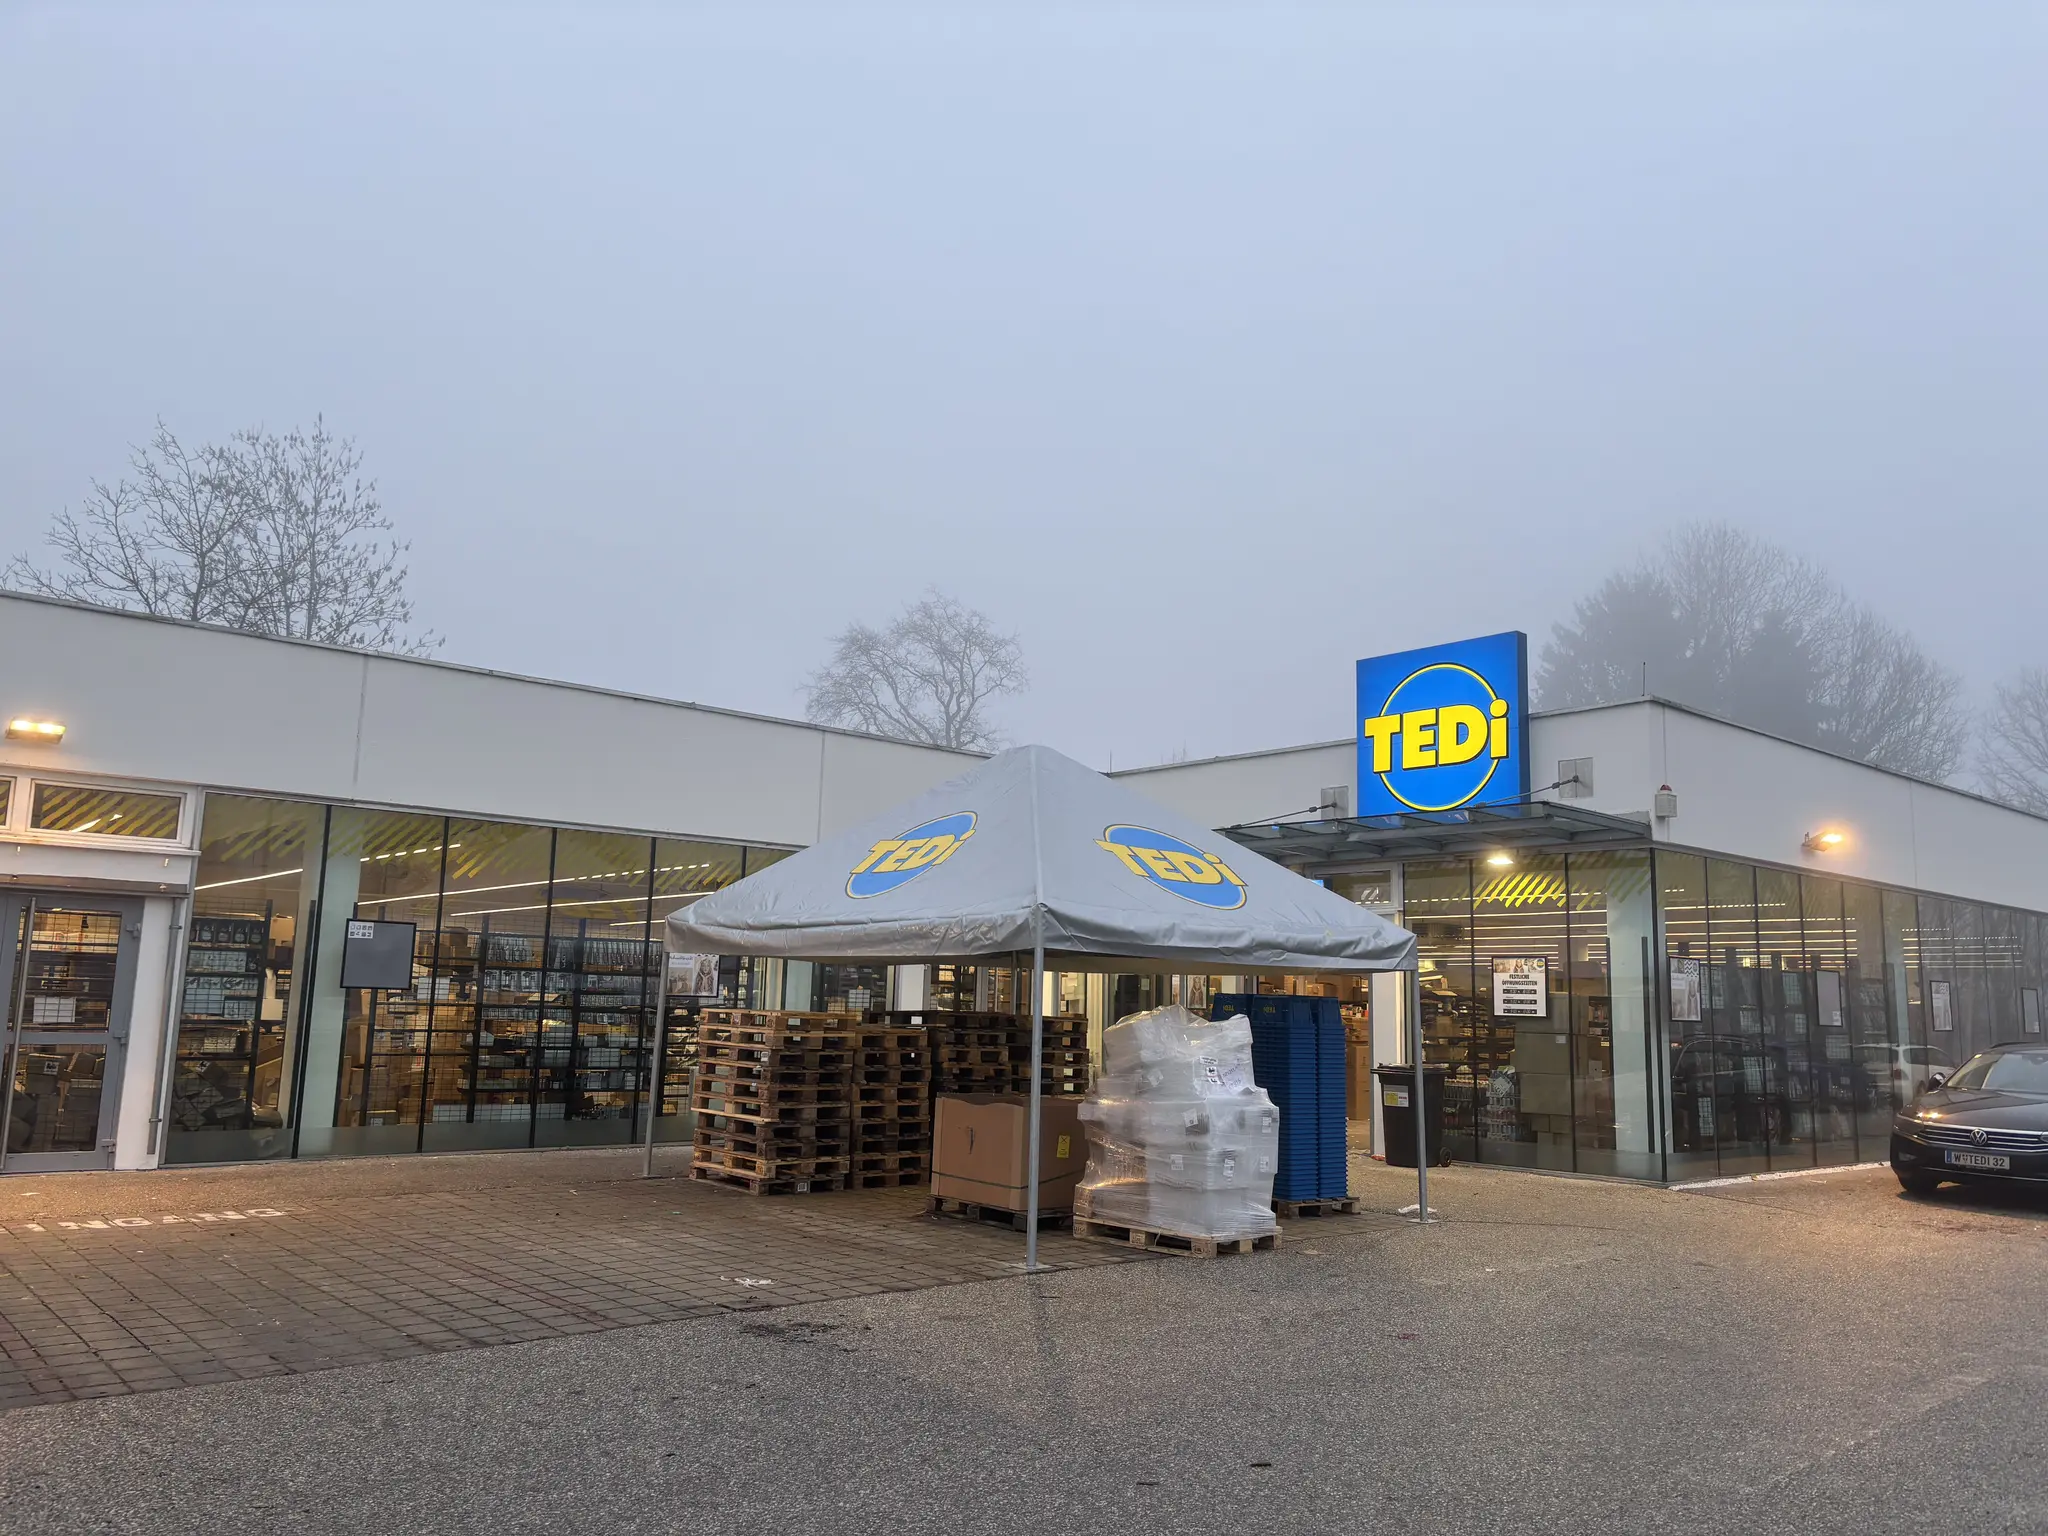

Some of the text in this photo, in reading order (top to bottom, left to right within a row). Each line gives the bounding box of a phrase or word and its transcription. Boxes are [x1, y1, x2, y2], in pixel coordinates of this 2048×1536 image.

[1364, 698, 1509, 774] TEDi
[849, 828, 977, 875] TEDi
[1093, 838, 1248, 886] TEDi
[1953, 1152, 2005, 1167] W TEDI 32
[0, 1208, 286, 1234] INGANG
